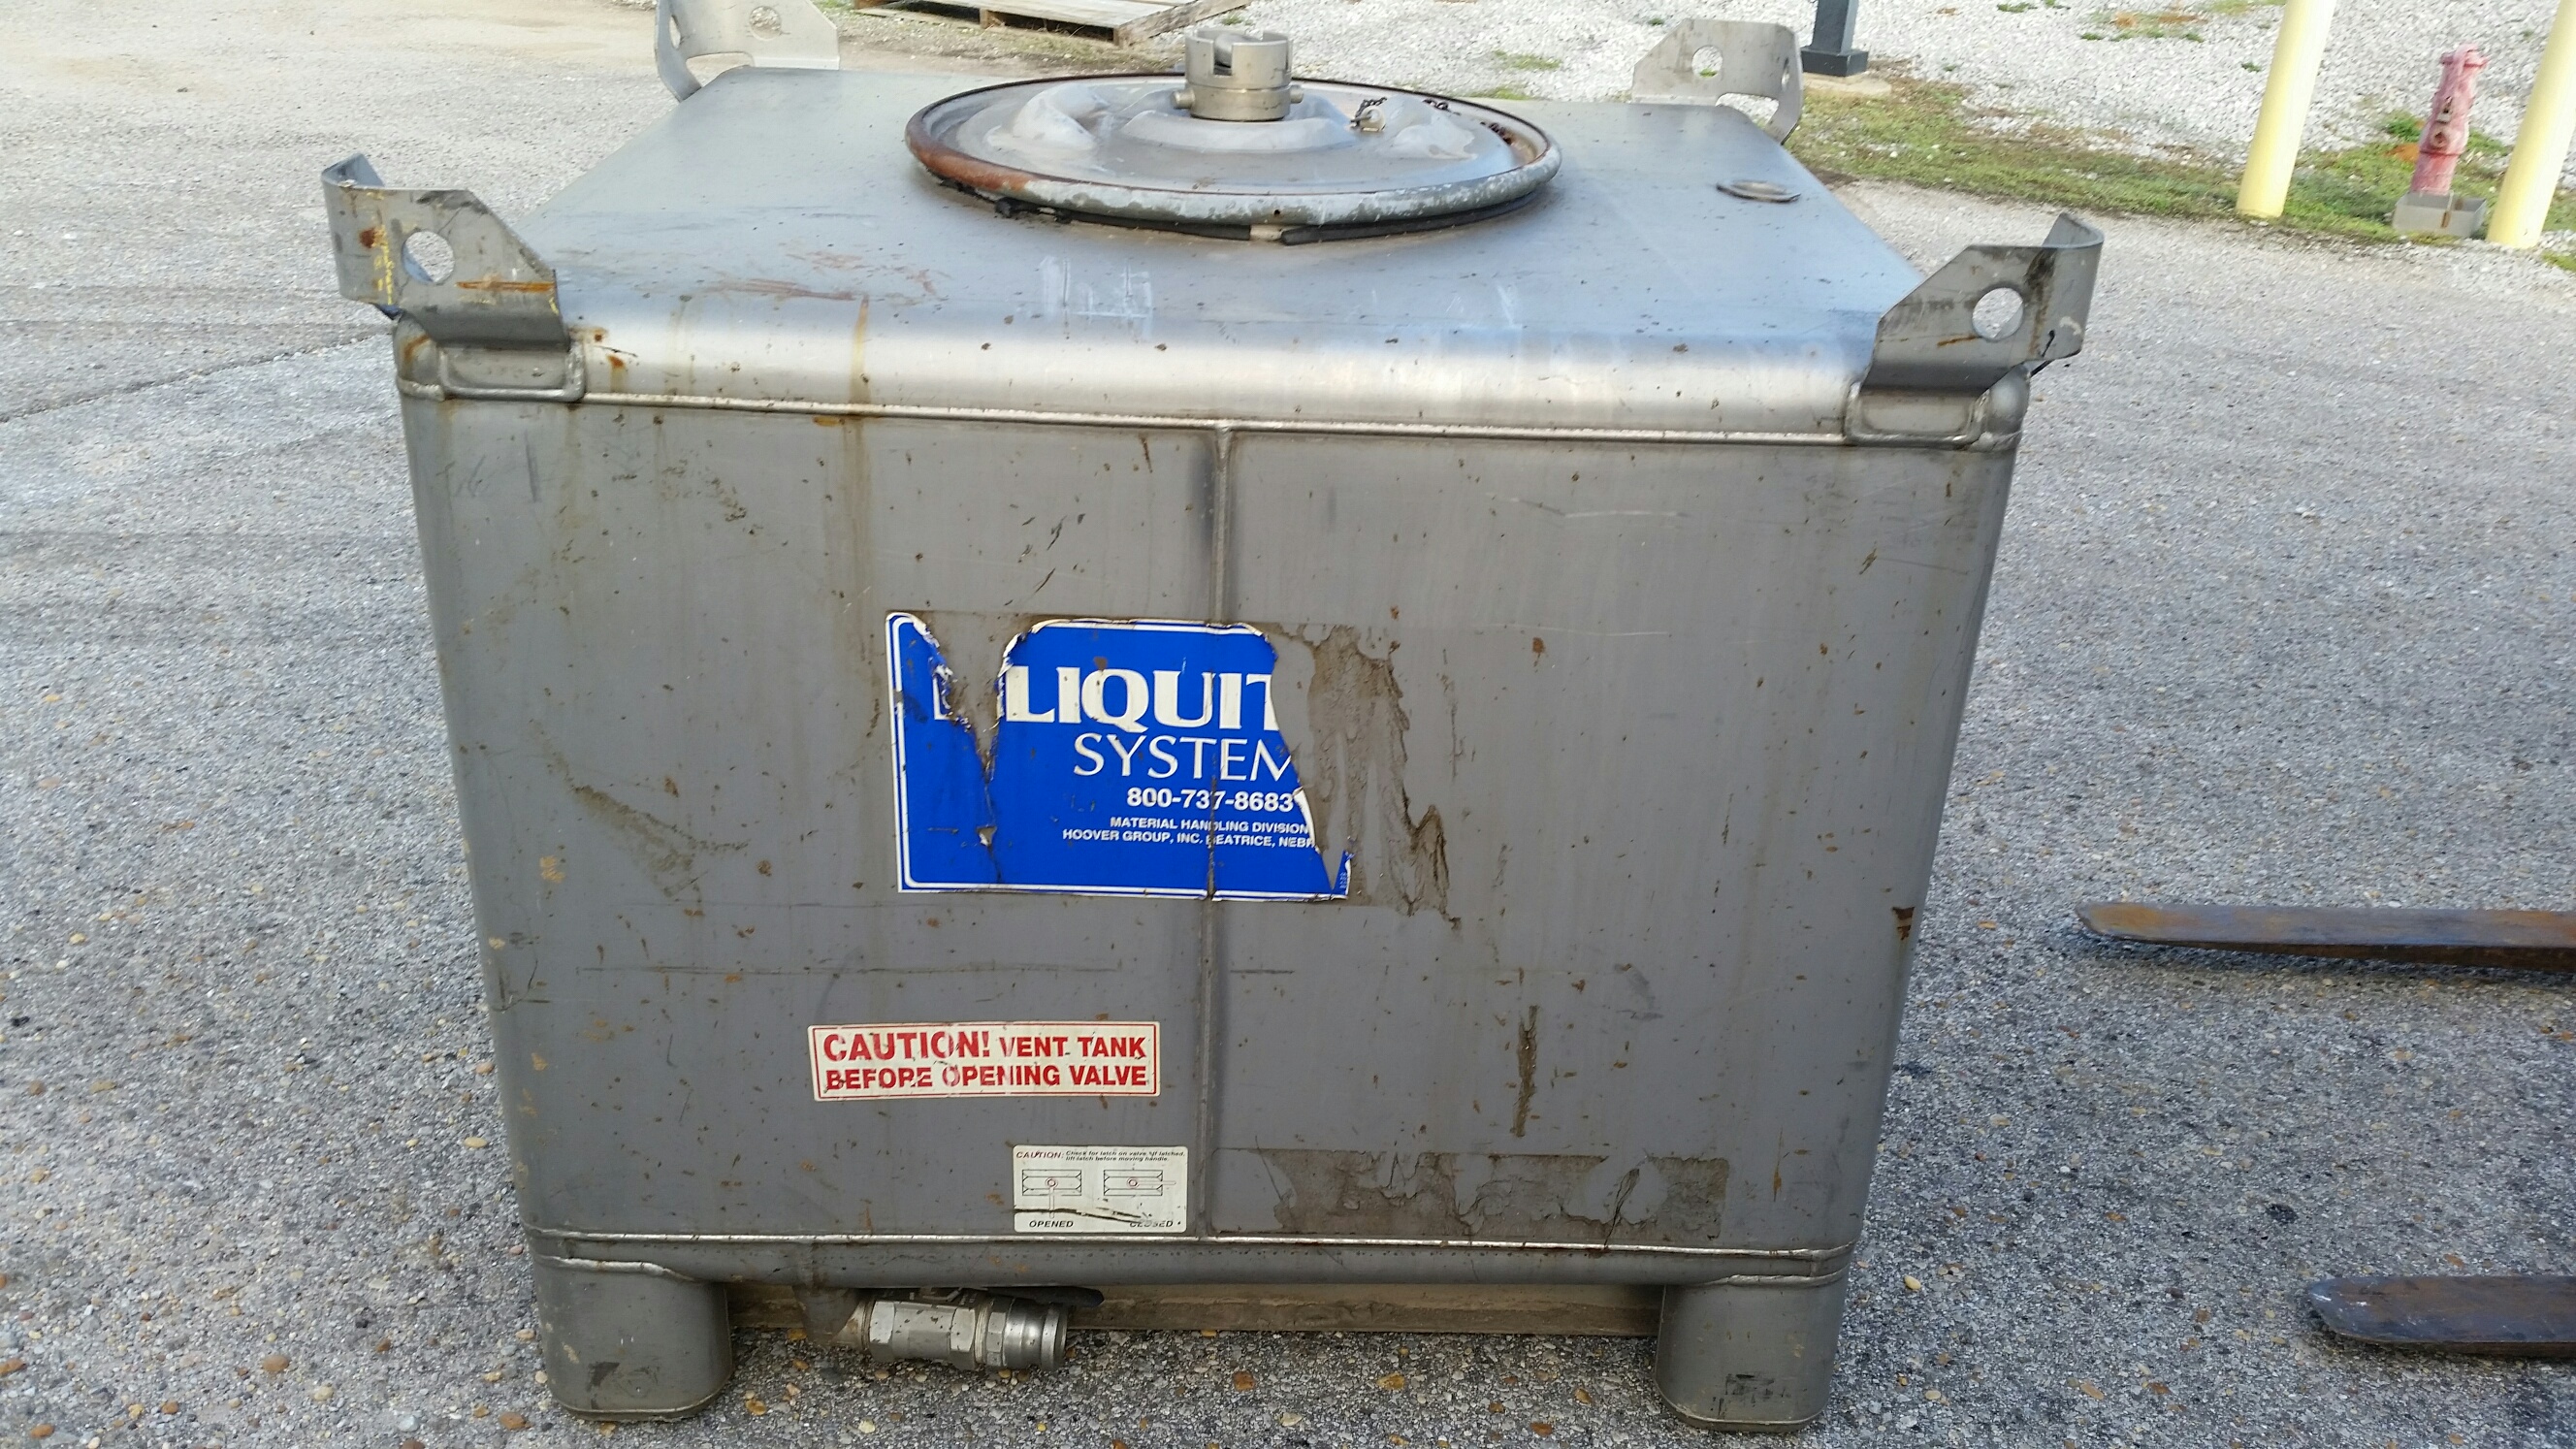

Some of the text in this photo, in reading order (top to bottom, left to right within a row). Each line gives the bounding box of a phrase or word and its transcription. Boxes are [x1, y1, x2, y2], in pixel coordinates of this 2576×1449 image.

[1127, 787, 1294, 813] 800-737-8683
[1110, 816, 1309, 834] MATERIAL HANDLING DIVISION
[1062, 828, 1119, 841] HOOVER
[1122, 830, 1174, 845] GROUP,
[823, 1030, 1147, 1062] CAUTION! VENT TANK
[826, 1065, 1147, 1091] BEFORE OPENING VALVE
[1029, 1219, 1074, 1228] OPENED
